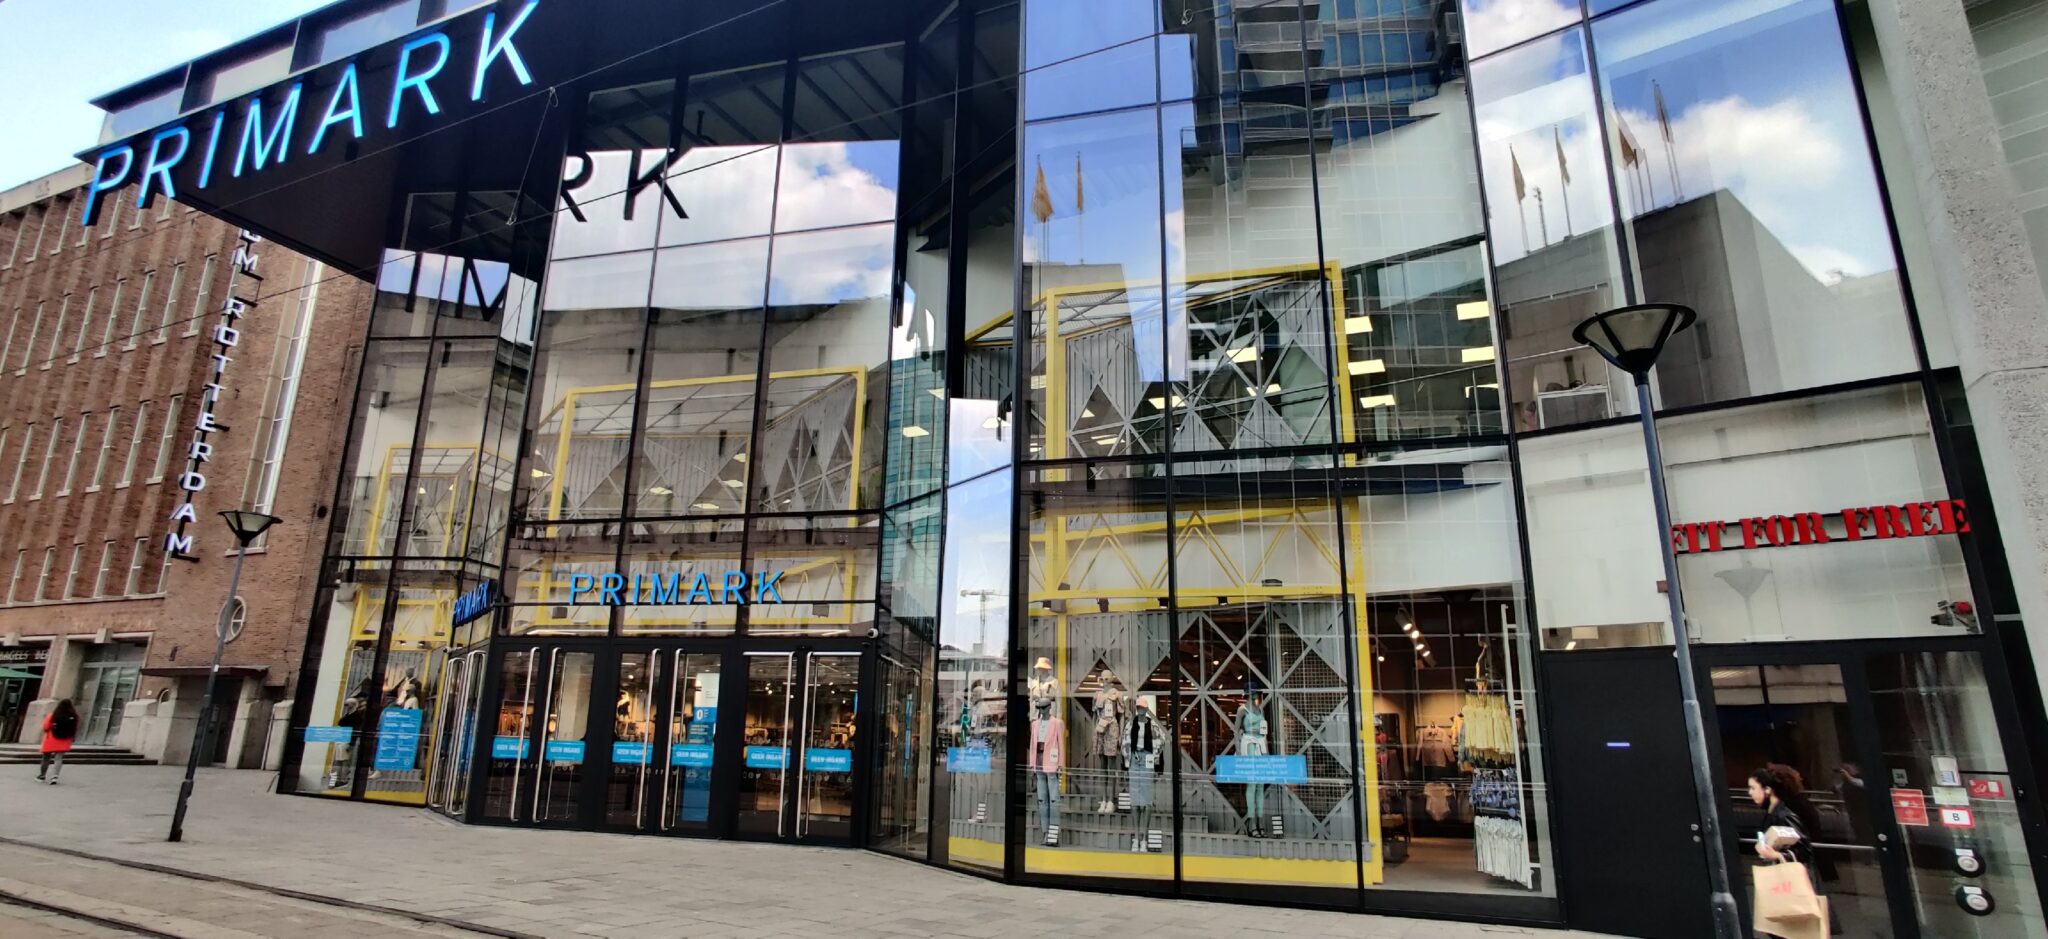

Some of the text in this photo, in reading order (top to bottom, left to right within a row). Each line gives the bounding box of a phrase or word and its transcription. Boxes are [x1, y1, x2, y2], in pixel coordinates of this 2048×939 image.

[82, 0, 540, 226] PRIMARK
[164, 298, 246, 554] ROTTERDAM
[568, 569, 785, 606] PRIMARK
[1738, 511, 1831, 550] FOR
[1840, 498, 1972, 542] FREE
